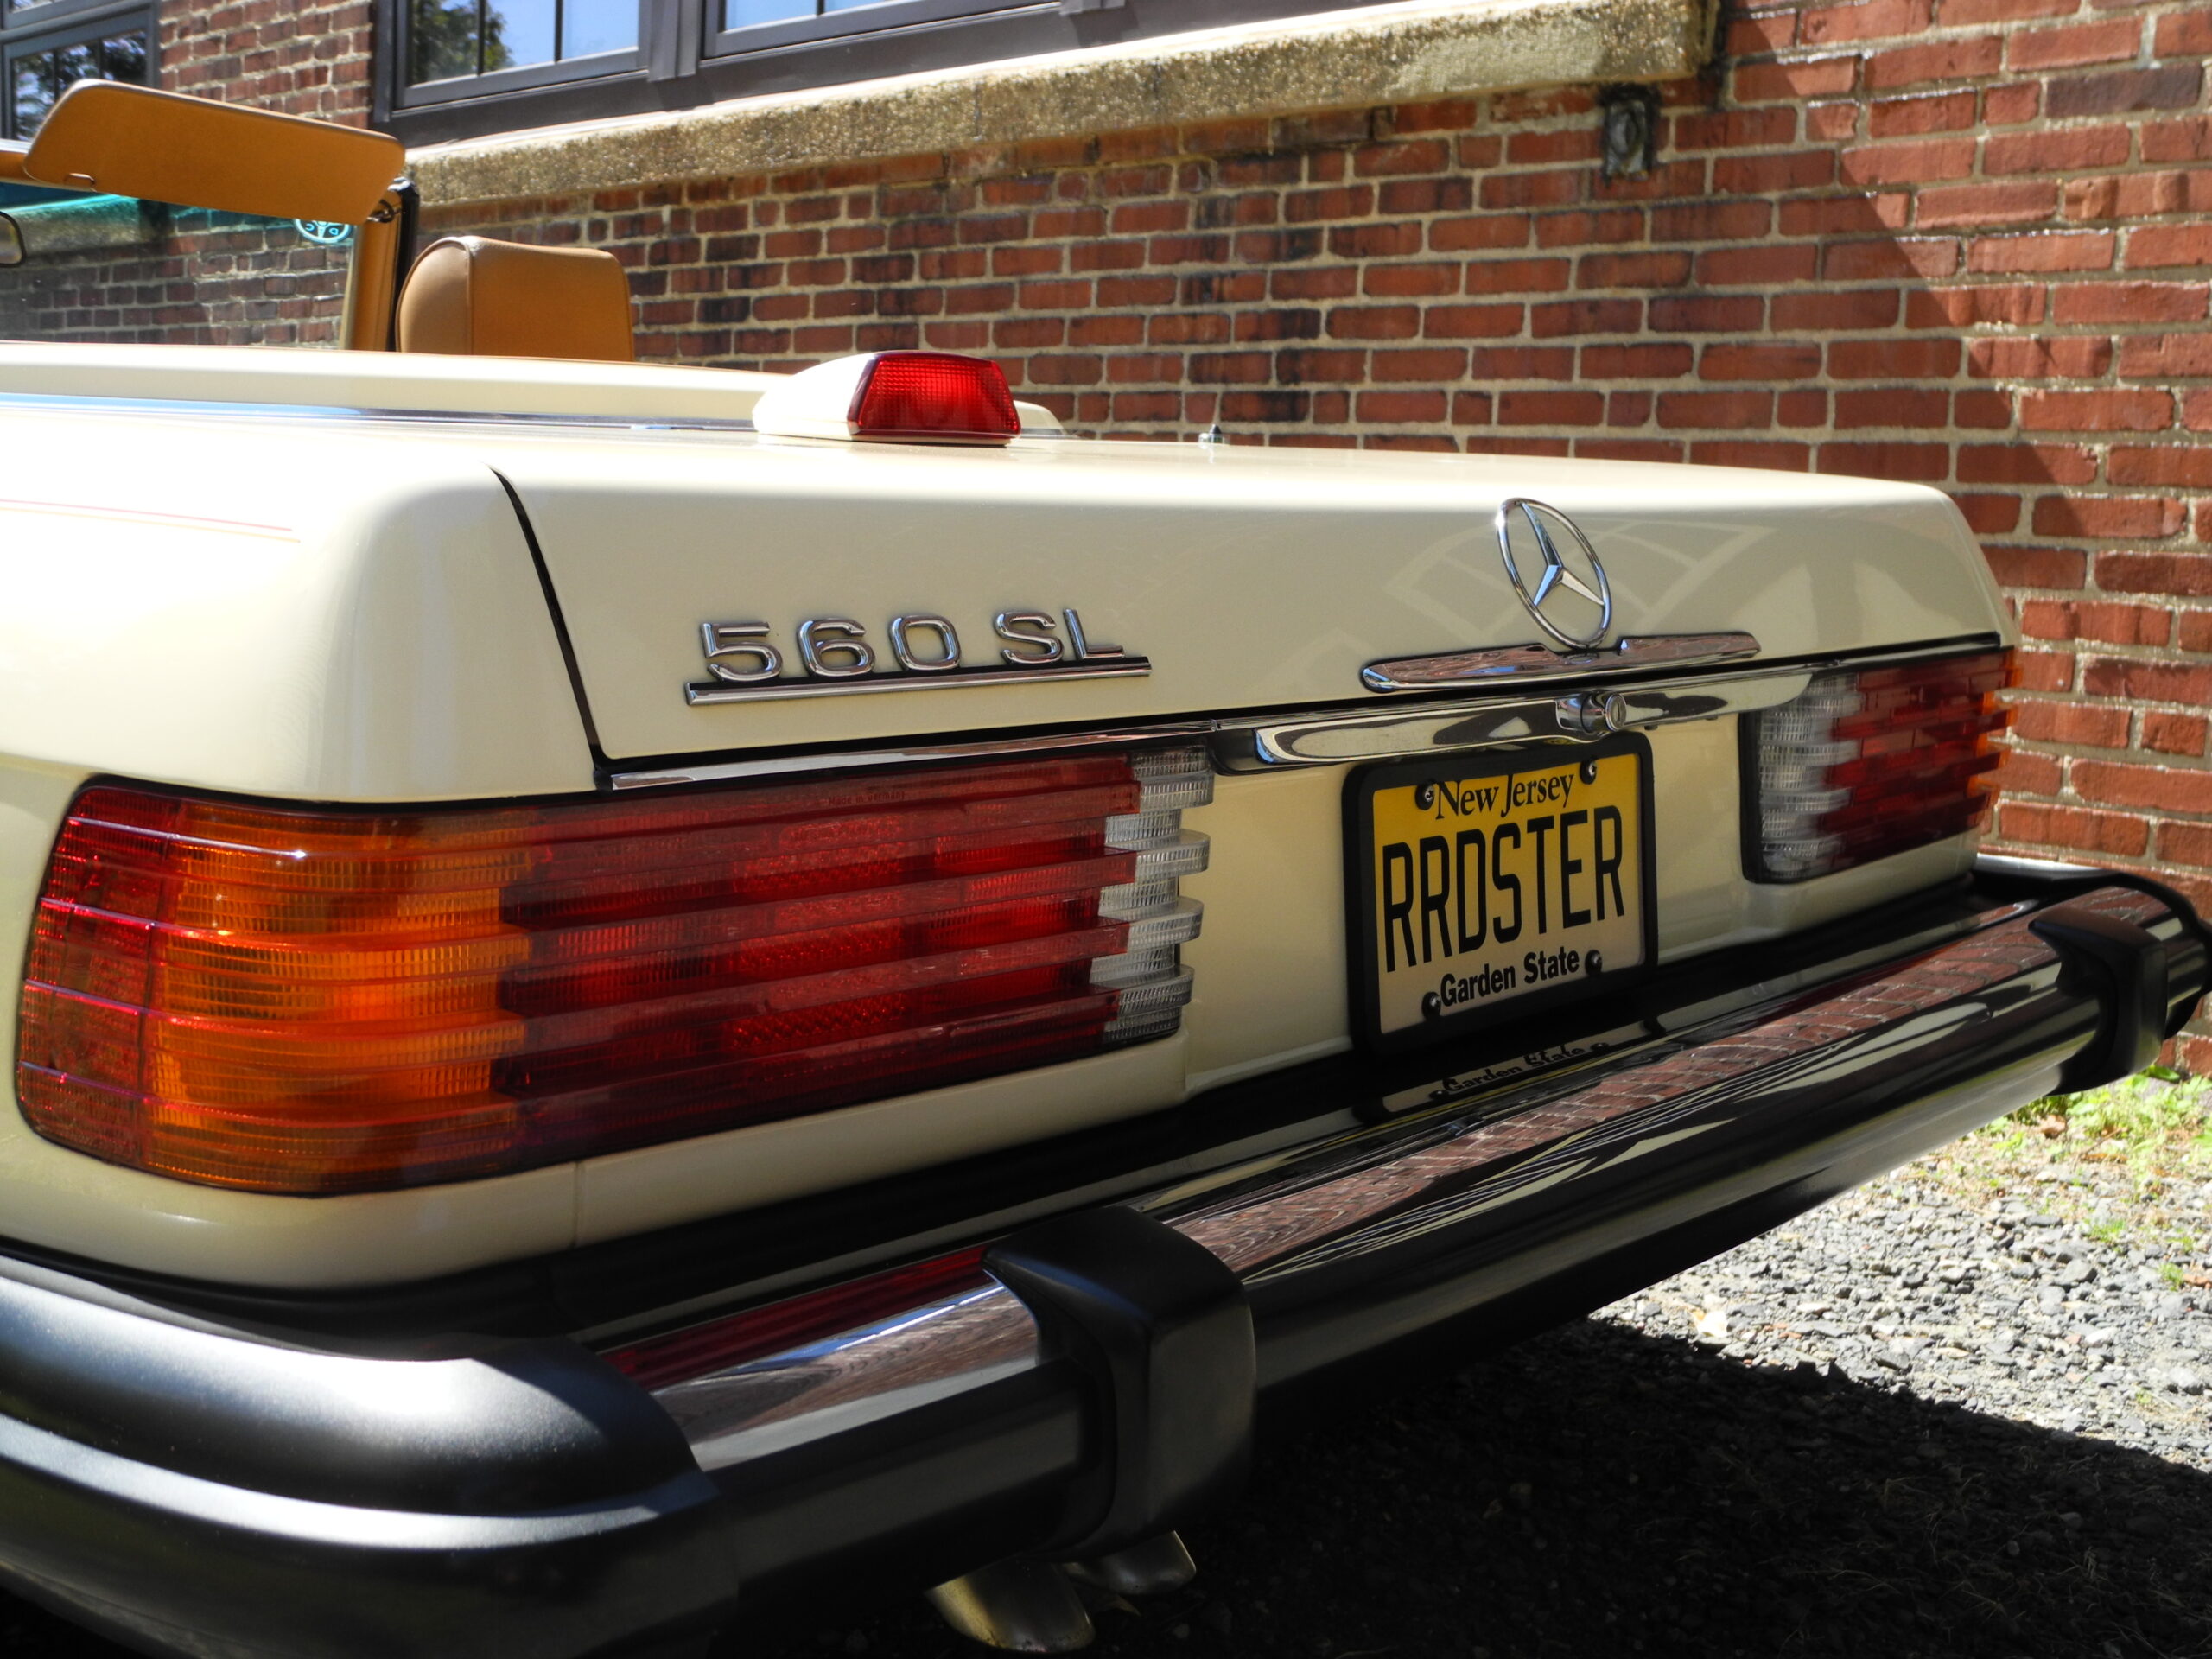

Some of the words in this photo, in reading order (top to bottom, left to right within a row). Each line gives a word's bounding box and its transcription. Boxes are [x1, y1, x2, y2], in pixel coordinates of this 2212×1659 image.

[700, 614, 961, 682] 560
[995, 608, 1125, 664] SL
[1435, 779, 1499, 820] New
[1500, 773, 1574, 818] Jersey
[1382, 804, 1625, 973] RRDSTER
[1440, 963, 1516, 1007] Garden
[1523, 946, 1580, 984] State
